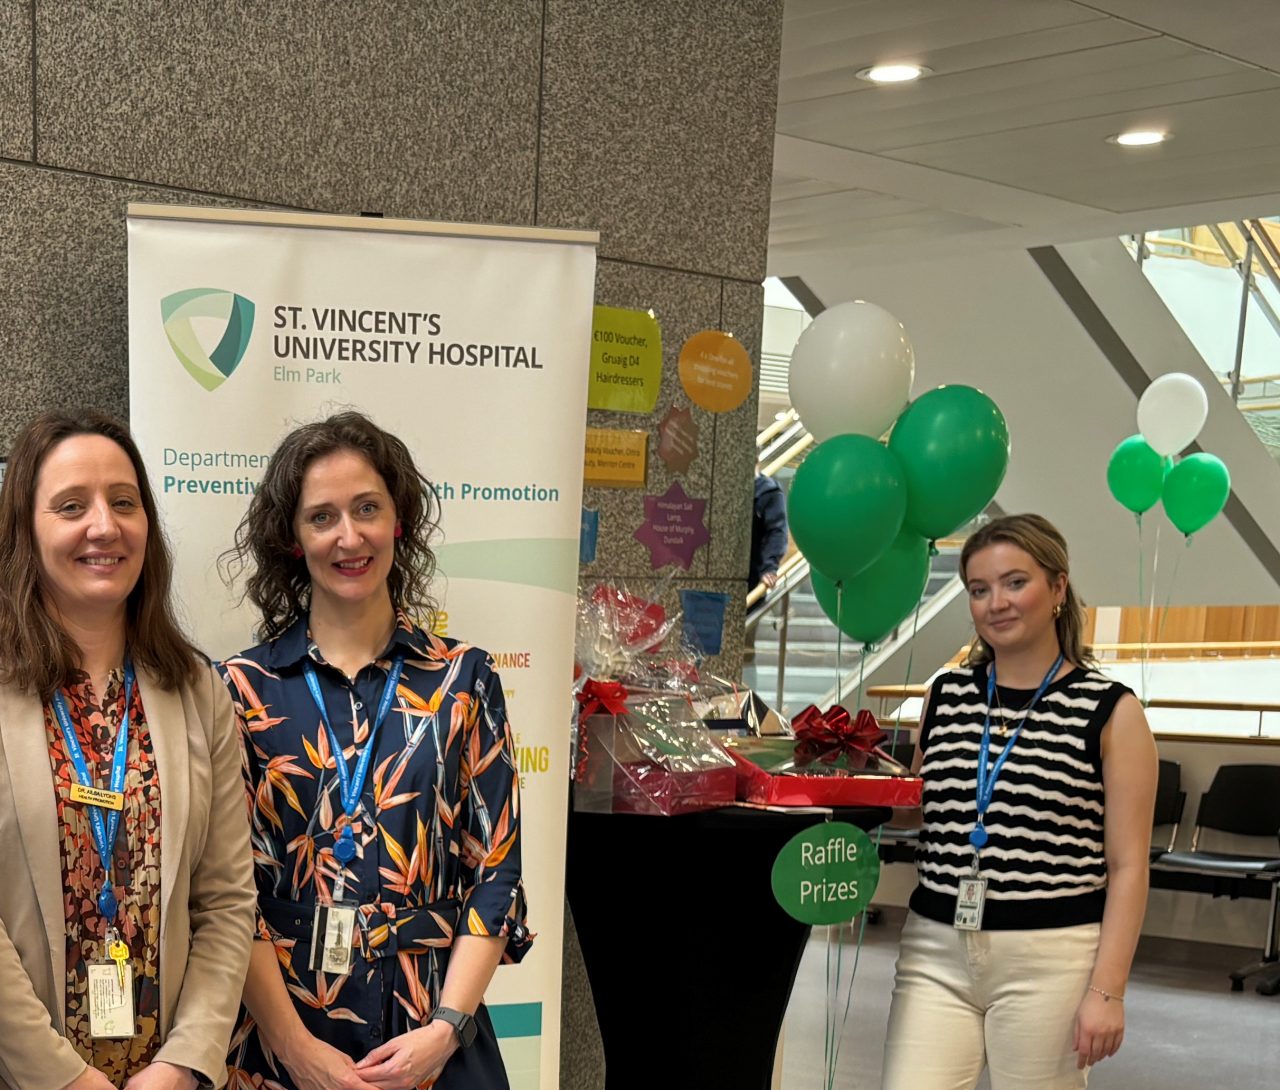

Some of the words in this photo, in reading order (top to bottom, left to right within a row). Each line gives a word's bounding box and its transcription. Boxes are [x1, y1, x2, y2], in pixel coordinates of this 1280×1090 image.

[274, 305, 306, 330] ST.
[312, 308, 441, 336] VINCENT'S
[594, 330, 614, 342] €100
[616, 332, 647, 348] Voucher,
[274, 335, 421, 364] UNIVERSITY
[428, 342, 544, 370] HOSPITAL
[602, 353, 627, 368] Gruaig
[629, 355, 639, 366] D4
[274, 366, 301, 382] Elm
[306, 368, 342, 384] Park
[596, 372, 643, 386] Hairdressers
[164, 448, 270, 472] Departmen
[164, 476, 260, 494] Preventiv
[462, 483, 559, 502] Promotion
[801, 838, 857, 866] Raffle
[800, 878, 858, 904] Prizes
